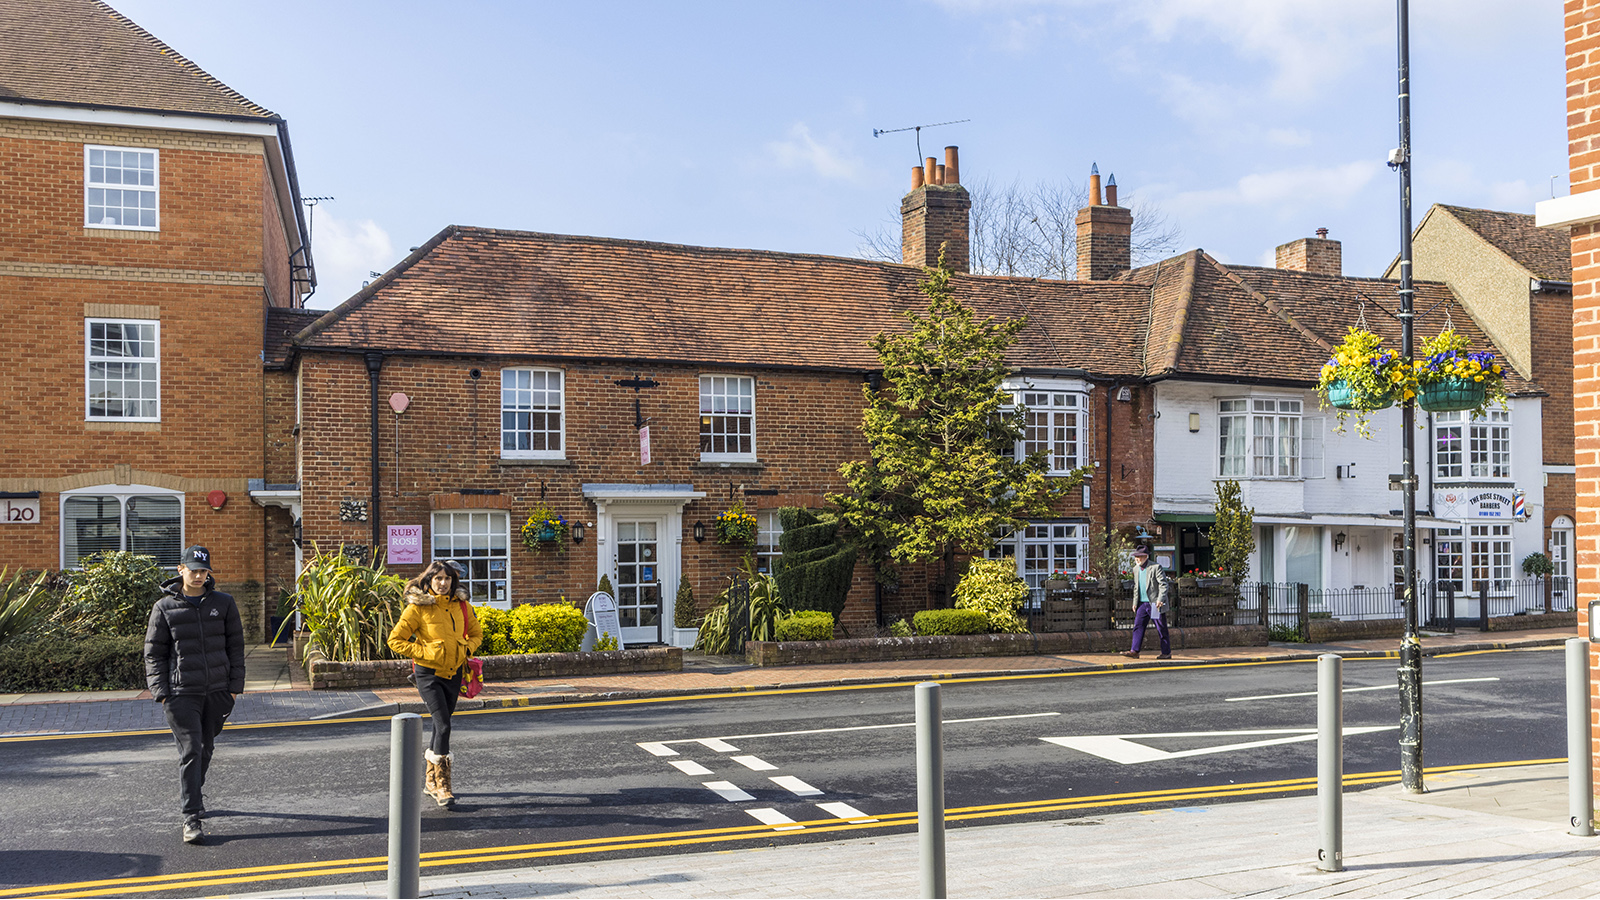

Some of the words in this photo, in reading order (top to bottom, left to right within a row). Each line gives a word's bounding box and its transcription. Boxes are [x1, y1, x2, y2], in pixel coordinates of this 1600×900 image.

[1470, 496, 1479, 505] THE
[1479, 493, 1492, 501] ROSE
[1493, 494, 1510, 506] STREET
[391, 528, 419, 536] RUBY
[392, 537, 418, 546] ROSE
[193, 550, 207, 561] NY
